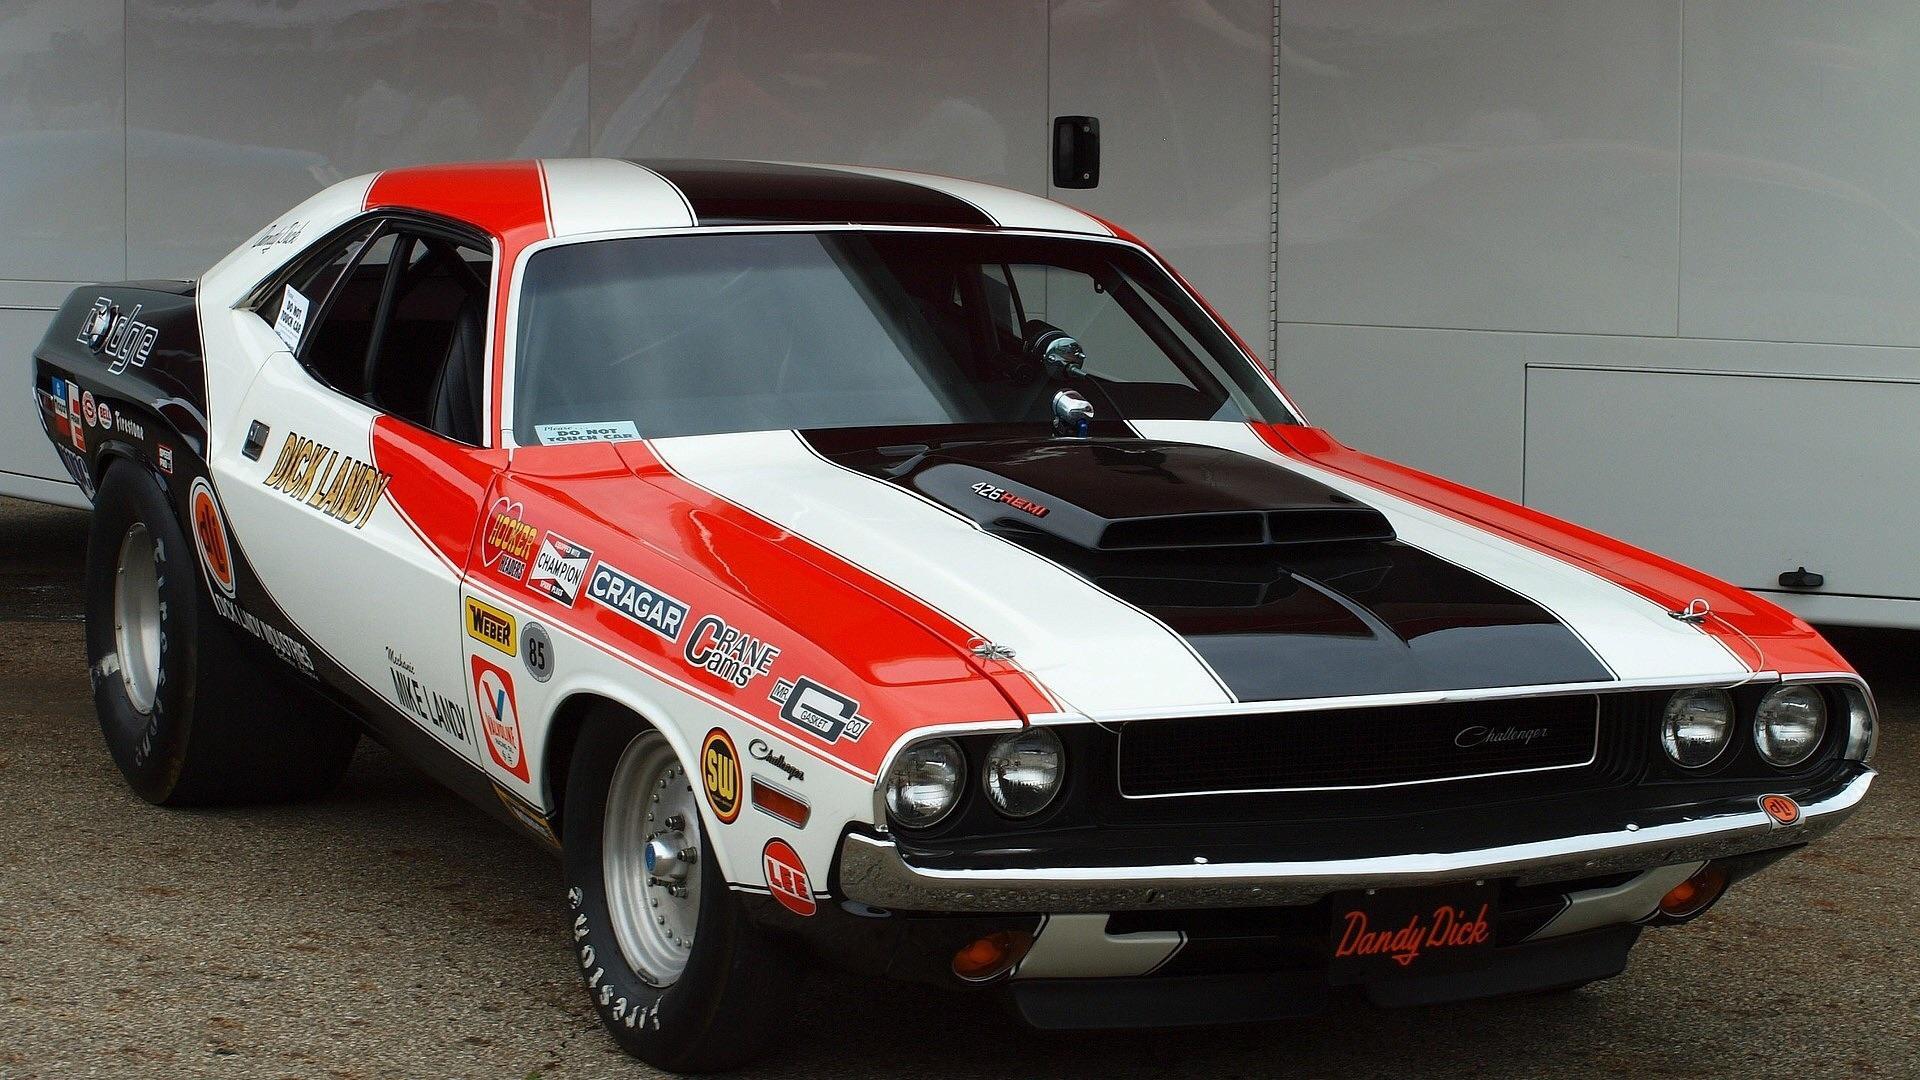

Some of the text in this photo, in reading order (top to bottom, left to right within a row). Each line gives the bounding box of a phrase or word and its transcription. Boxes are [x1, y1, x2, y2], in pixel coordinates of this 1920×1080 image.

[115, 410, 144, 440] Firestone
[263, 431, 393, 529] DICK LANDY
[971, 482, 1049, 518] 426 HEMI
[488, 513, 538, 561] HOOKER
[499, 555, 526, 579] HEADERS
[537, 552, 583, 586] CHAMPION
[592, 571, 683, 636] CRAGAR
[469, 604, 511, 648] WEBER
[685, 616, 780, 674] CRANE
[529, 637, 545, 670] 85
[390, 667, 472, 746] MIKE LANDY
[800, 710, 829, 730] GASKET
[1454, 726, 1548, 748] Challenger
[707, 749, 734, 800] SW
[748, 738, 804, 781] Challenger
[767, 858, 811, 901] LEE
[1335, 903, 1491, 966] Dandy Dick
